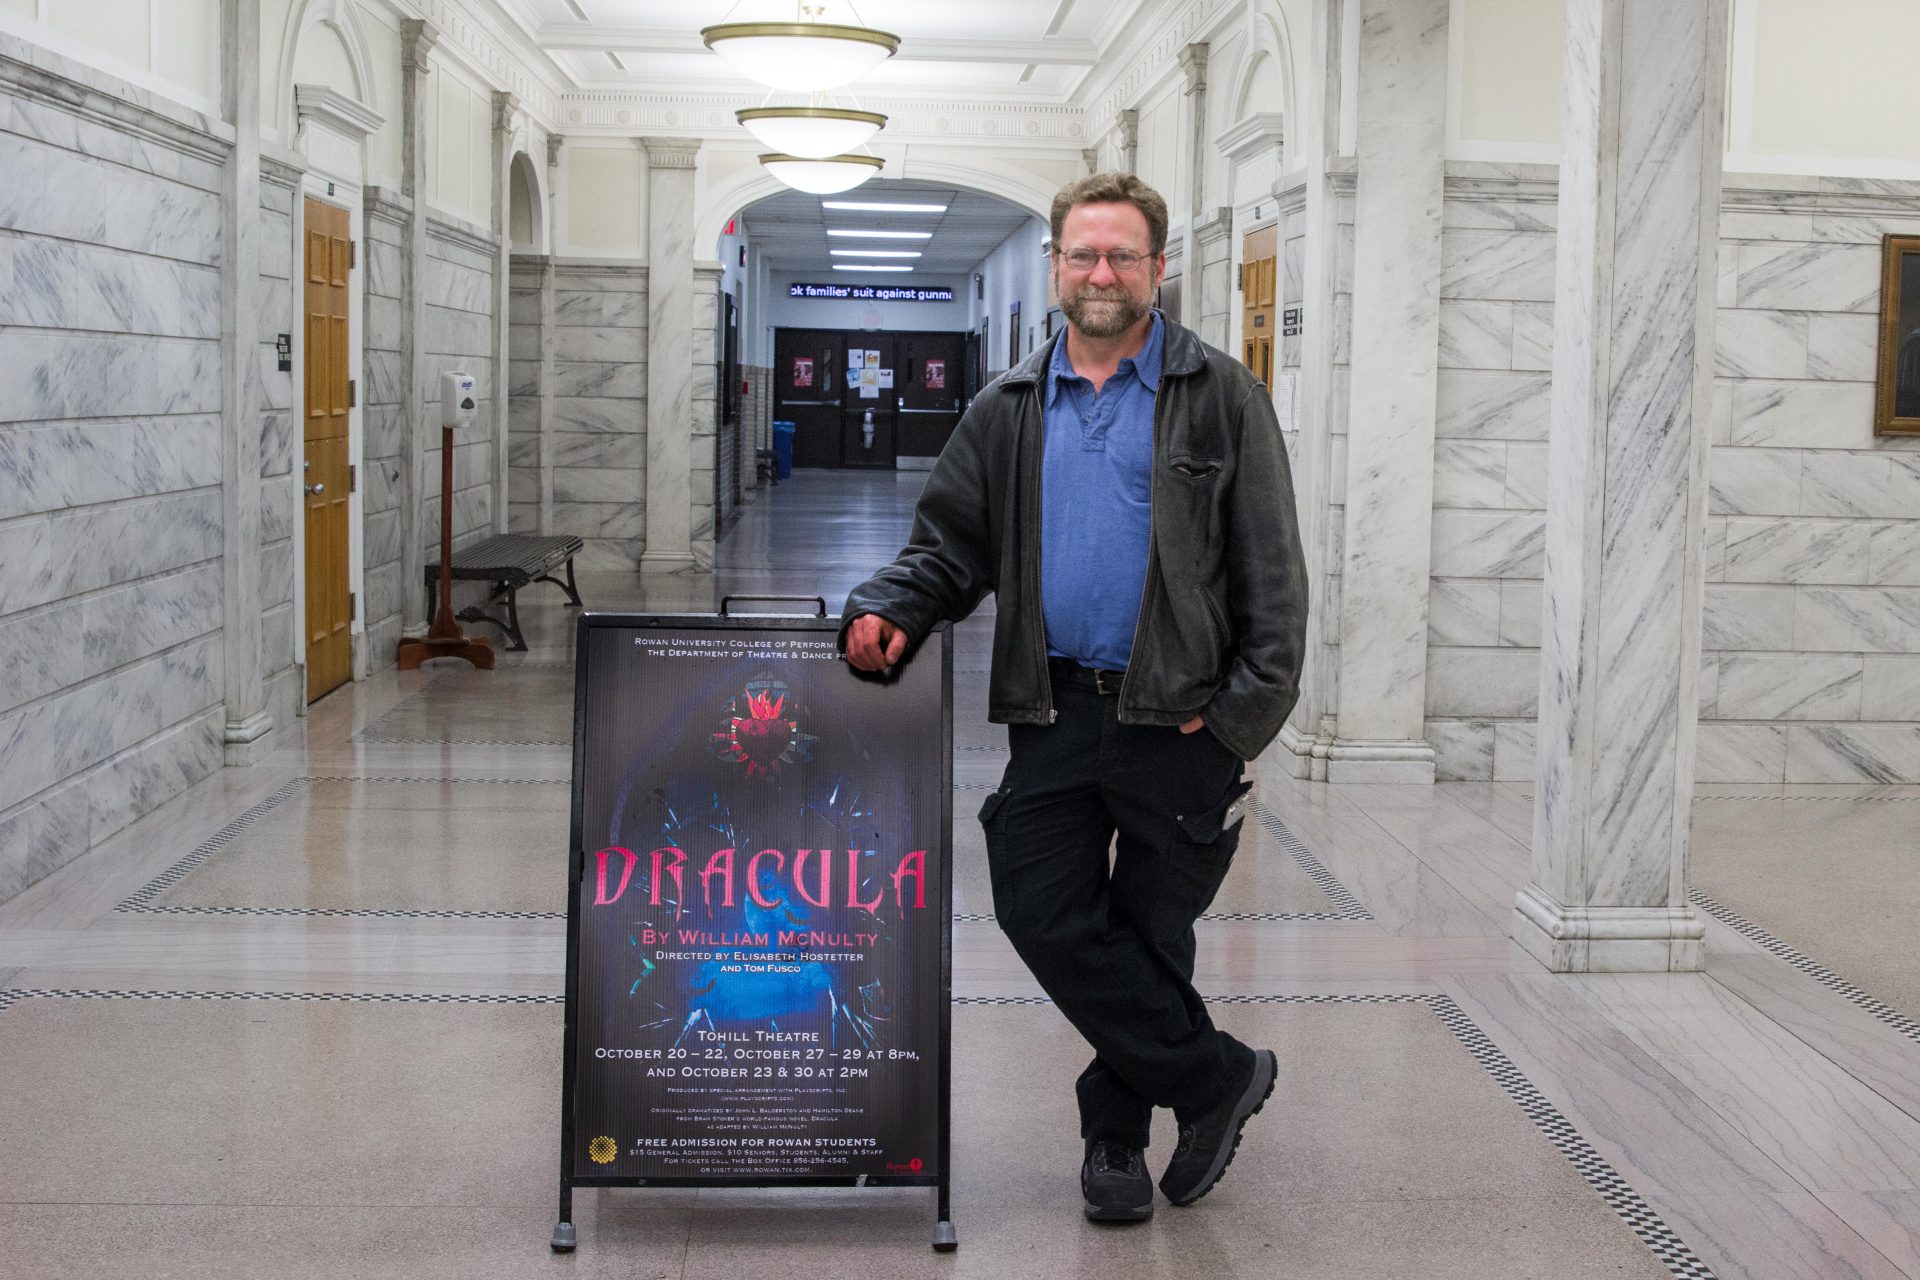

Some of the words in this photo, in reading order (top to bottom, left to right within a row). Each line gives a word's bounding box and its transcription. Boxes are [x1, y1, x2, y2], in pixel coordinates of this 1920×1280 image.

[806, 286, 850, 297] families'
[853, 287, 874, 298] suit
[876, 288, 916, 300] against
[634, 637, 668, 646] ROWAN
[672, 638, 727, 647] UNIVERSITY
[730, 639, 772, 648] COLLEGE
[790, 640, 837, 649] PERFORMI
[668, 650, 729, 658] DEPARTMENT
[747, 650, 788, 659] THEATRE
[592, 846, 928, 922] DRACULA
[642, 930, 668, 946] BY
[678, 930, 769, 946] WILLIAM
[778, 930, 878, 947] MCNULTY
[656, 950, 712, 960] DIRECTED
[715, 952, 730, 960] BY
[734, 952, 796, 961] ELISABETH
[800, 952, 864, 961] HOSTETTER
[744, 964, 765, 972] TOM
[768, 964, 801, 973] FUSCO
[698, 1030, 750, 1042] TOHILL
[756, 1030, 819, 1042] THEATRE
[595, 1048, 662, 1059] OCTOBER
[667, 1048, 687, 1059] 20
[734, 1048, 800, 1060] OCTOBER
[805, 1049, 824, 1060] 27
[843, 1049, 861, 1060] 29
[866, 1050, 884, 1060] AT
[646, 1068, 676, 1077] AND
[682, 1067, 748, 1077] OCTOBER
[754, 1067, 772, 1078] 23
[778, 1067, 788, 1078] &
[794, 1067, 813, 1078] 30
[818, 1068, 834, 1078] AT
[840, 1067, 868, 1078] 2PM
[637, 1139, 668, 1147] FREE
[671, 1139, 737, 1147] ADMISSION
[741, 1139, 764, 1147] FOR
[768, 1139, 811, 1147] ROWAN
[815, 1139, 876, 1147] STUDENTS
